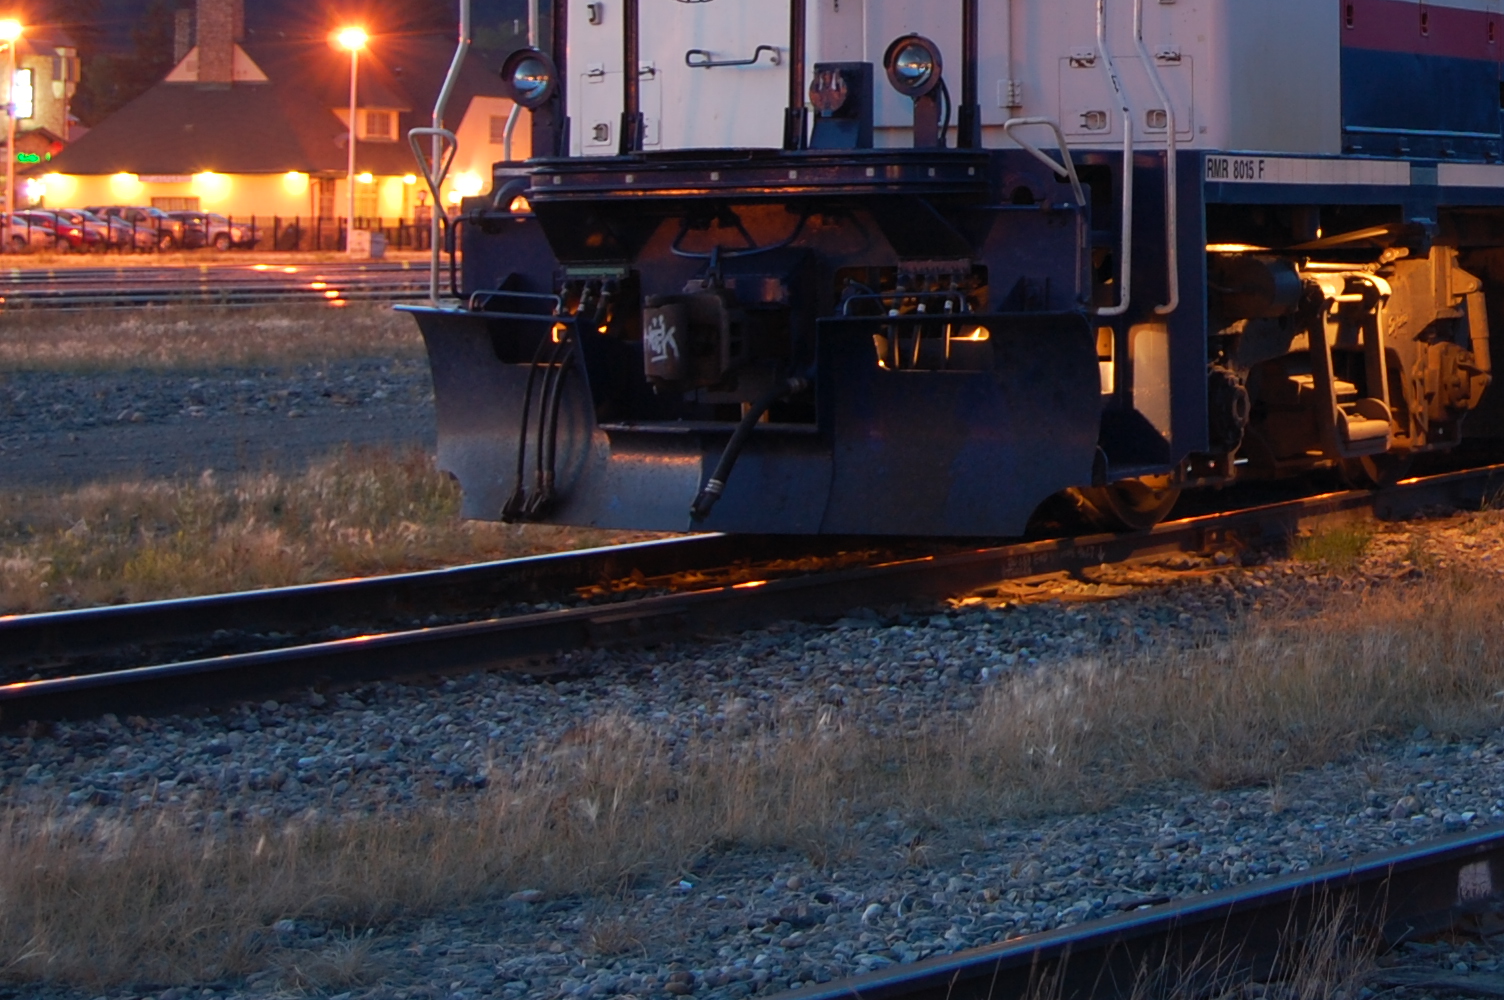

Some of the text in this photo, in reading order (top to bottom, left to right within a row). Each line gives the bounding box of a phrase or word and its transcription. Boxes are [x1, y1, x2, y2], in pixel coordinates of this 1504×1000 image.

[1206, 158, 1265, 179] RMR 8015 F
